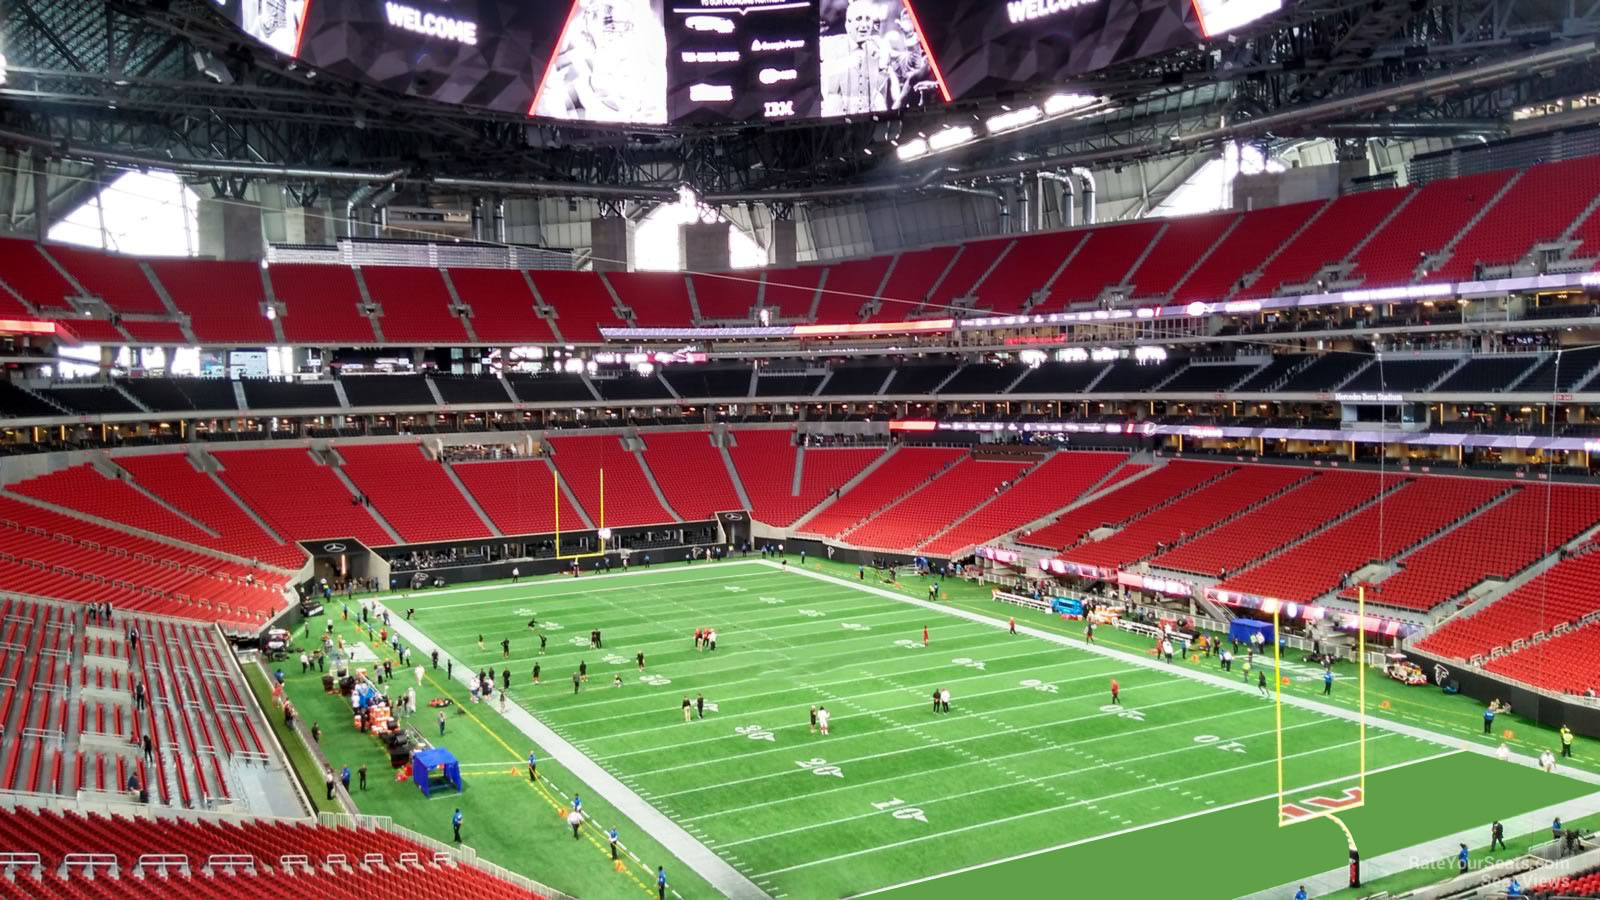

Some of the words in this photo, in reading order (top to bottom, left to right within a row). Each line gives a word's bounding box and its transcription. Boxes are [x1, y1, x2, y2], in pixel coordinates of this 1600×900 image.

[385, 1, 477, 45] WELCOME
[764, 101, 795, 117] IBM
[1378, 393, 1403, 401] Stadium
[870, 797, 924, 819] 10
